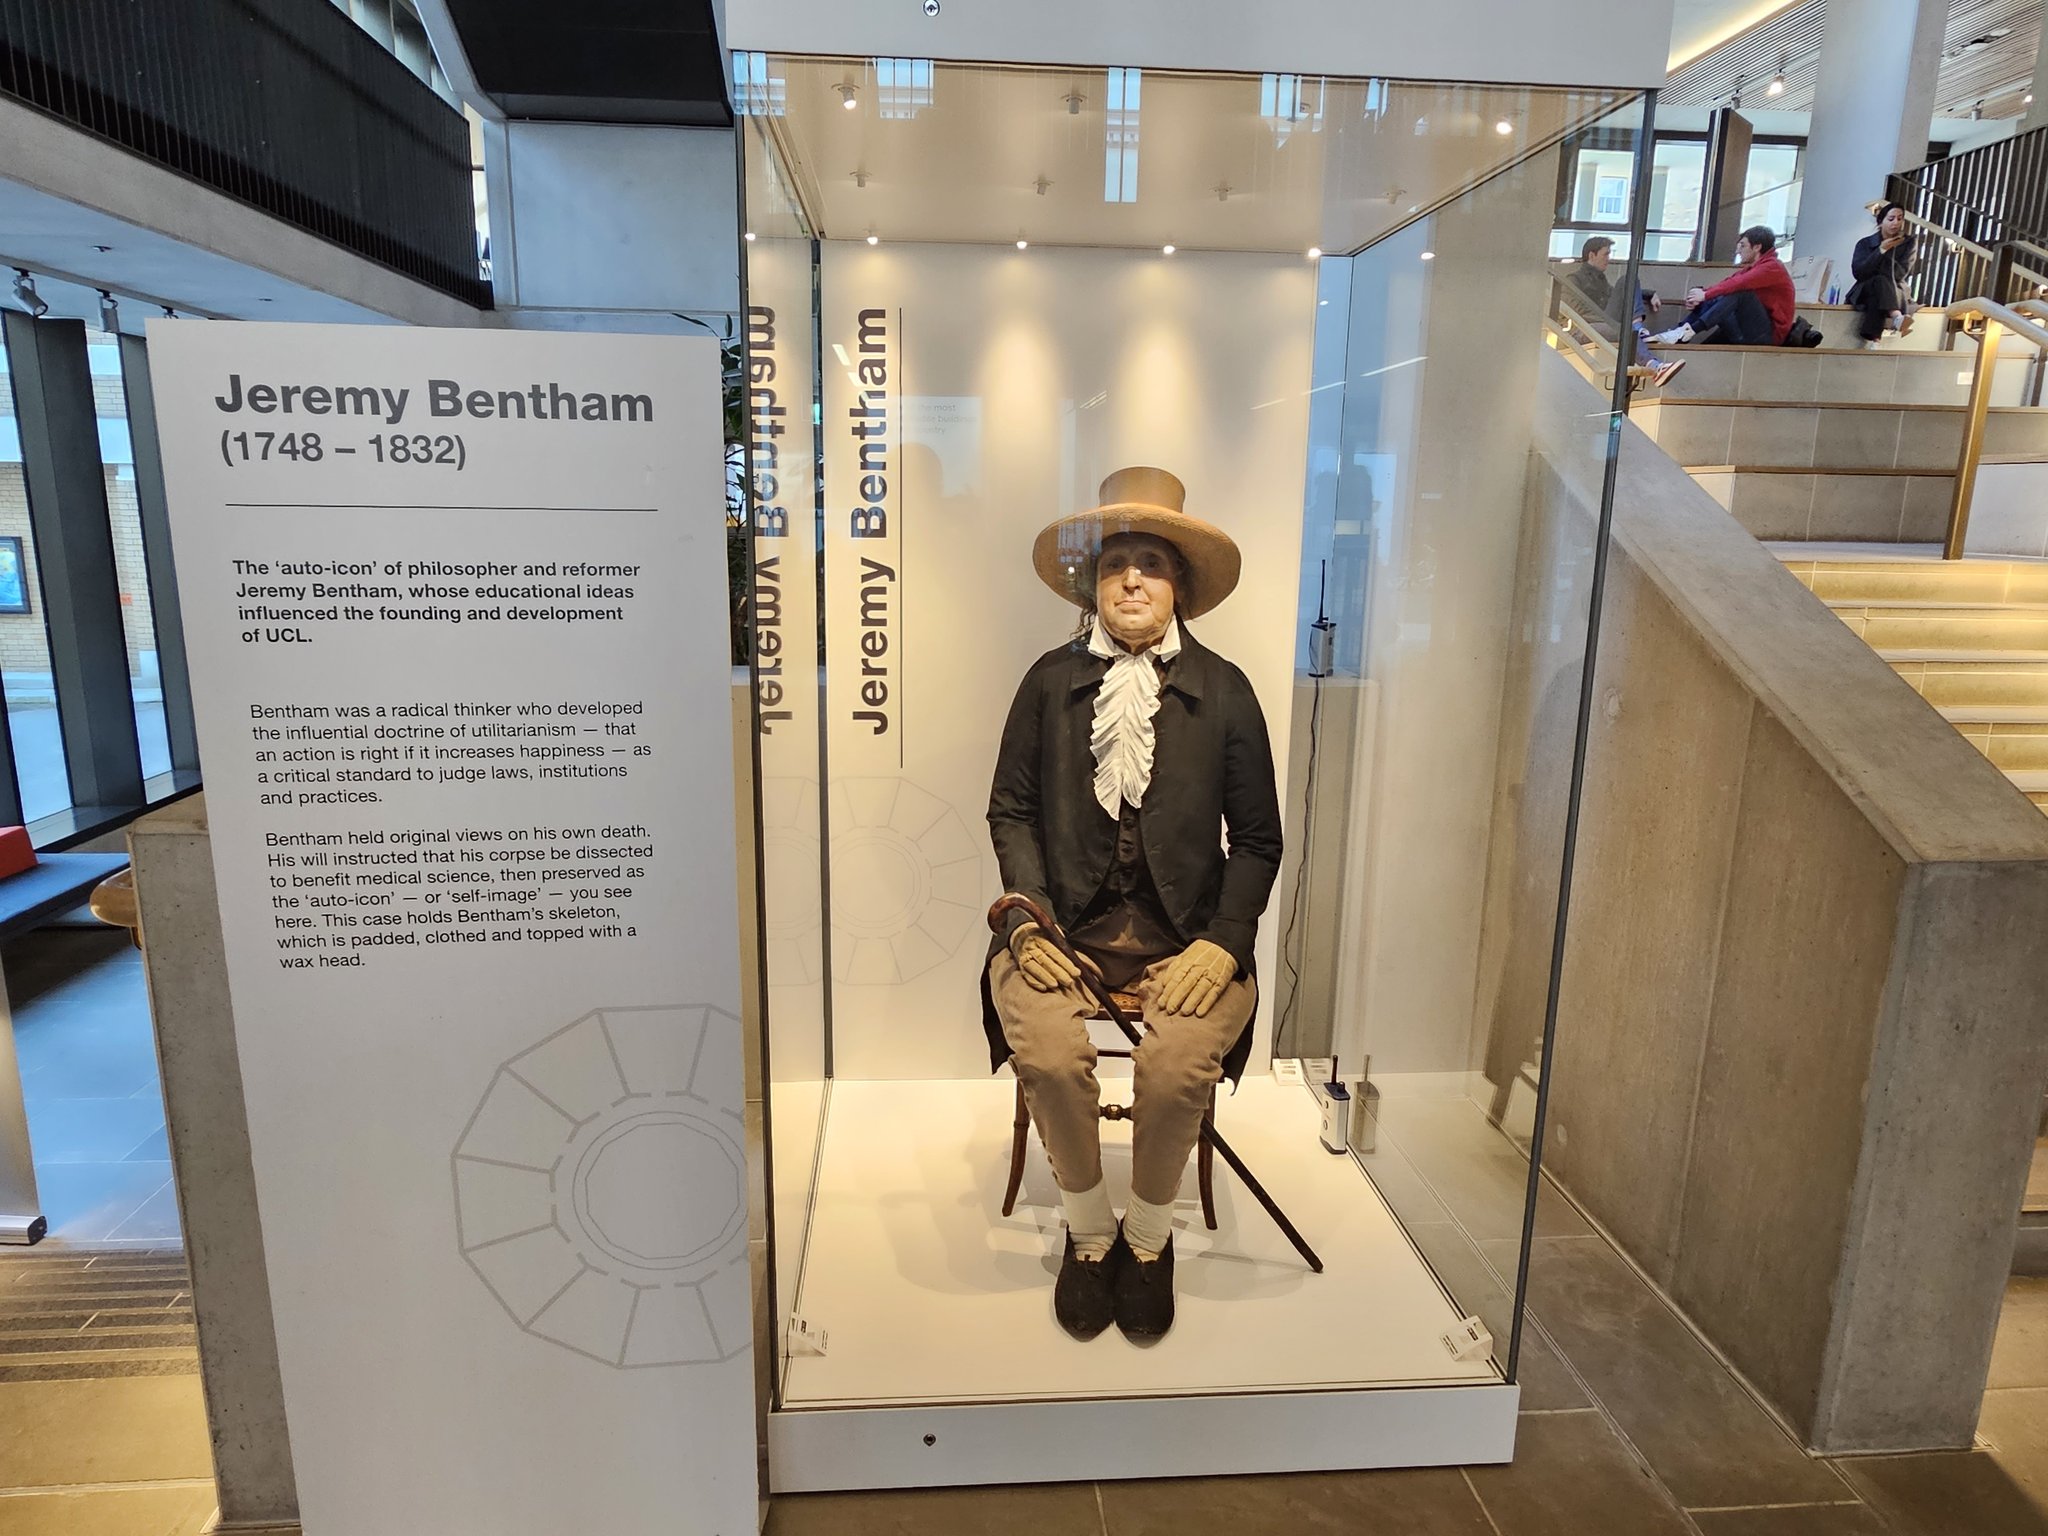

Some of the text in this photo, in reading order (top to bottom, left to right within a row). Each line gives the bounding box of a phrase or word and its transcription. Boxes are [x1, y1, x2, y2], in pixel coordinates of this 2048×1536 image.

[215, 374, 653, 424] Jeremy Bentham
[221, 430, 323, 467] (1748
[368, 434, 466, 471] 1832)
[849, 308, 896, 735] Jeremy Bentham
[232, 560, 269, 575] The
[384, 561, 402, 575] of
[408, 561, 518, 579] philosopher
[523, 562, 556, 576] and
[563, 562, 640, 576] reformer
[236, 583, 634, 601] Jeremy Bentham, whose educational ideas
[238, 605, 623, 624] influenced the founding and development
[242, 628, 312, 643] of UCL.
[250, 700, 643, 718] Bentham was a radical thinker who developed
[252, 726, 280, 740] the
[286, 725, 368, 740] influential
[374, 724, 444, 739] doctrine
[450, 724, 466, 738] of
[472, 723, 576, 737] utilitarianism
[604, 722, 636, 736] that
[256, 751, 277, 762] an
[283, 747, 335, 762] action
[341, 746, 355, 761] is
[360, 746, 399, 763] right
[404, 746, 414, 759] if
[419, 745, 430, 759] it
[435, 745, 515, 759] increases
[520, 743, 605, 760] happiness
[633, 745, 651, 756] as
[258, 764, 628, 784] a critical standard to judge laws, institutions
[260, 789, 382, 807] and practices.
[265, 824, 650, 846] Bentham held original views on his own death.
[268, 844, 653, 867] His will instructed that his corpse be dissected
[269, 865, 645, 888] to benefit medical science, then preserved as
[272, 895, 299, 908] the
[425, 893, 442, 904] or
[569, 889, 598, 902] you
[604, 887, 632, 898] see
[275, 915, 317, 929] here.
[321, 913, 357, 927] This
[362, 915, 402, 926] case
[407, 910, 453, 924] holds
[549, 906, 620, 920] skeleton,
[277, 924, 637, 949] which is padded, clothed and topped with a
[279, 953, 365, 968] wax head.
